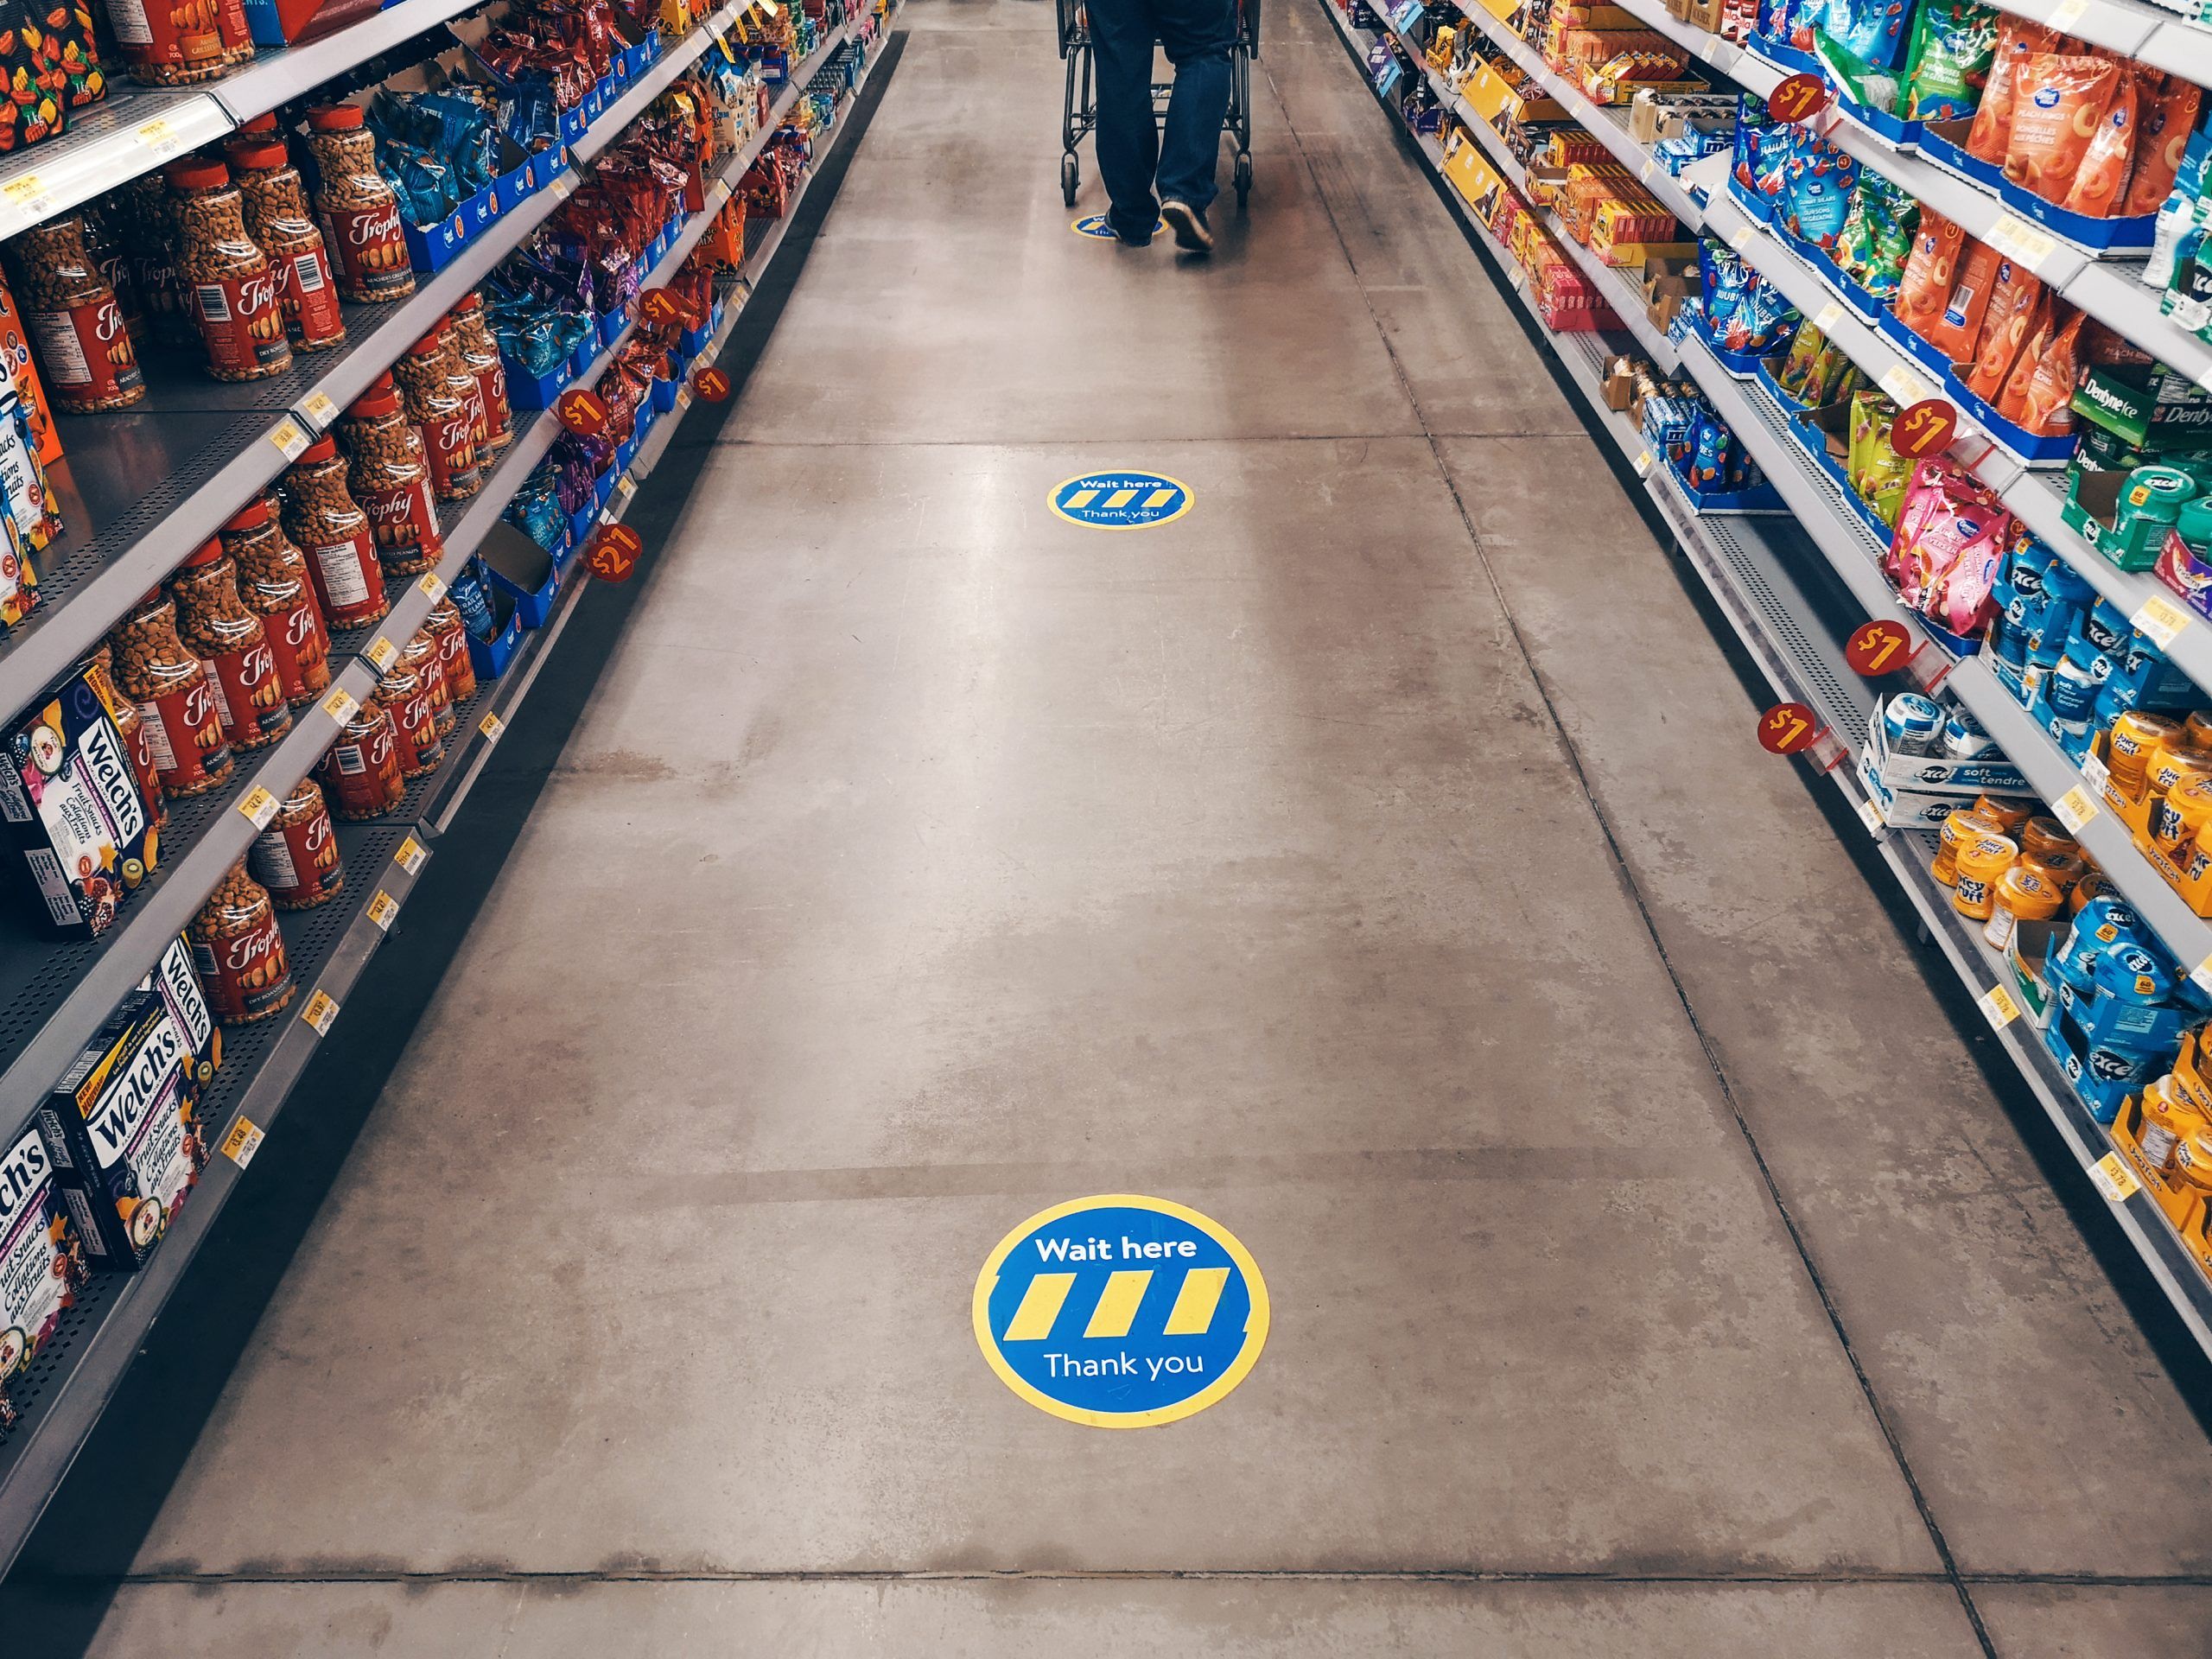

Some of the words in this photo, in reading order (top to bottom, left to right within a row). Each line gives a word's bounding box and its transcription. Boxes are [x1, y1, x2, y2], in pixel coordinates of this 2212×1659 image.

[1779, 80, 1817, 118] $1
[238, 277, 274, 315] Trop
[645, 292, 676, 319] $1
[698, 372, 726, 395] $1
[2085, 378, 2125, 412] Dentyne
[2121, 401, 2139, 419] Ice
[565, 394, 602, 426] $1
[2164, 406, 2212, 426] Denty
[439, 418, 469, 450] Trop
[1905, 407, 1949, 454] $1
[356, 490, 413, 524] Trophy
[593, 546, 631, 575] $2
[286, 604, 316, 645] Trop
[440, 629, 466, 661] Trop
[1858, 626, 1903, 671] $1
[239, 643, 273, 686] Trop
[421, 658, 442, 690] Trop
[403, 695, 429, 729] Trop
[1770, 709, 1808, 749] $1
[2115, 740, 2136, 756] Fruit
[2118, 733, 2139, 748] Juicy
[86, 727, 137, 836] Welch's
[1915, 766, 1957, 782] excel
[1981, 775, 2026, 786] tendre
[2159, 775, 2176, 787] Fru
[2160, 767, 2181, 782] Juic
[60, 804, 73, 821] aux
[70, 817, 86, 844] Fruits
[67, 798, 91, 839] Collations
[72, 782, 88, 807] Fruit
[86, 804, 102, 836] Snacks
[1920, 804, 1952, 818] exce
[1981, 839, 2004, 851] Juicy
[2106, 911, 2135, 923] excel
[2128, 950, 2152, 972] excel
[168, 950, 208, 1044] Welch's
[95, 1028, 175, 1151] Welch's
[136, 1131, 155, 1174] Fruit
[152, 1099, 178, 1141] Snacks
[146, 1122, 179, 1183] Collations
[150, 1167, 163, 1194] aux
[162, 1134, 181, 1170] Fruits
[2109, 1166, 2126, 1187] $3.78
[0, 1144, 45, 1227] ch's
[14, 1188, 33, 1217] OWNED
[14, 1217, 46, 1265] Snacks
[1035, 1237, 1112, 1262] Wait
[1122, 1236, 1197, 1259] here
[4, 1243, 48, 1312] Collations
[10, 1294, 25, 1325] aux
[24, 1254, 51, 1297] Fruits
[1044, 1351, 1138, 1377] Thank
[1146, 1356, 1204, 1381] you
